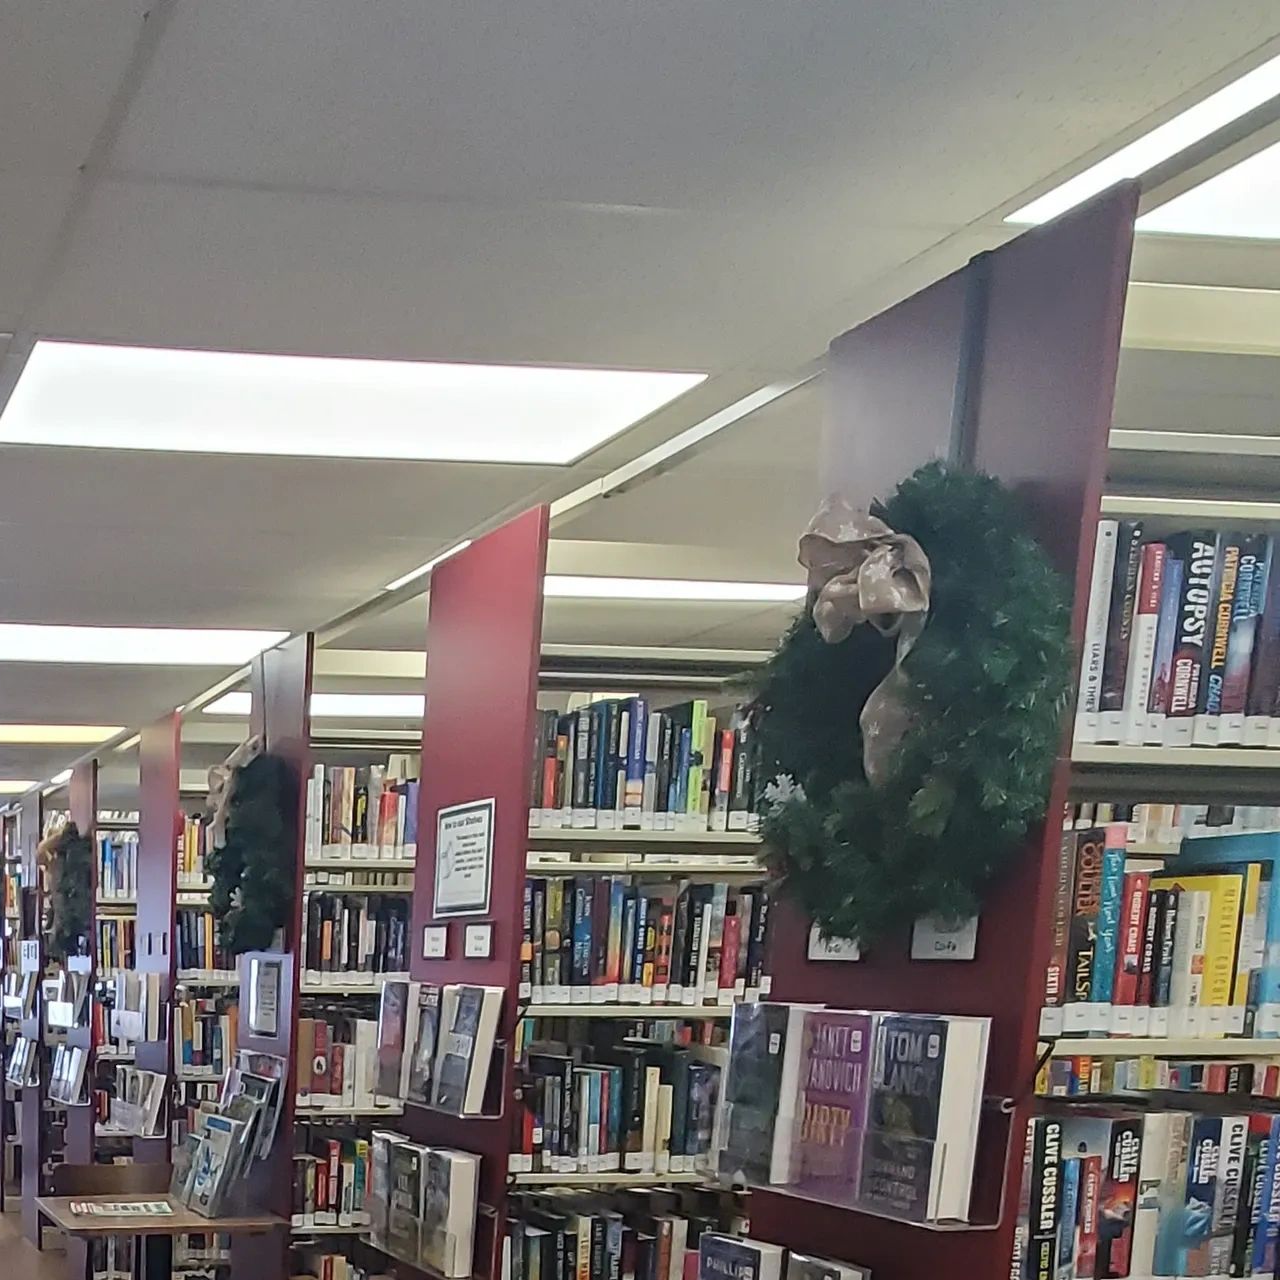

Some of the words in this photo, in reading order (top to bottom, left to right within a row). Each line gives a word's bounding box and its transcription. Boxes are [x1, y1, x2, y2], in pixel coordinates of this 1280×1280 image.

[1220, 546, 1240, 602] PATRICIA
[1233, 555, 1257, 622] CORNWELL
[1181, 541, 1215, 648] AUTOPSY
[1211, 603, 1232, 670] CORNWELL
[1089, 642, 1102, 672] LIARS
[1171, 658, 1194, 714] CORNWELL
[1076, 843, 1096, 917] COULTER
[1131, 891, 1142, 925] ROBERT
[1147, 907, 1157, 941] ROBERT
[1127, 926, 1138, 953] CRAIS
[1143, 942, 1154, 973] CRAIS
[1046, 966, 1060, 994] SIXTH
[812, 1024, 850, 1058] JANET
[889, 1031, 923, 1062] TOM
[1045, 1123, 1060, 1165] CLIVE
[1118, 1130, 1134, 1183] CUSSLER
[1199, 1138, 1214, 1184] CUSSLER
[1230, 1124, 1244, 1163] CLIVE
[1257, 1139, 1269, 1171] CLIVE
[1039, 1168, 1058, 1231] CUSSLER
[1220, 1166, 1239, 1232] CUSSLER
[1250, 1174, 1266, 1225] CUSSLER
[706, 1256, 745, 1279] PHILLIP
[1040, 1241, 1051, 1268] CELTIC
